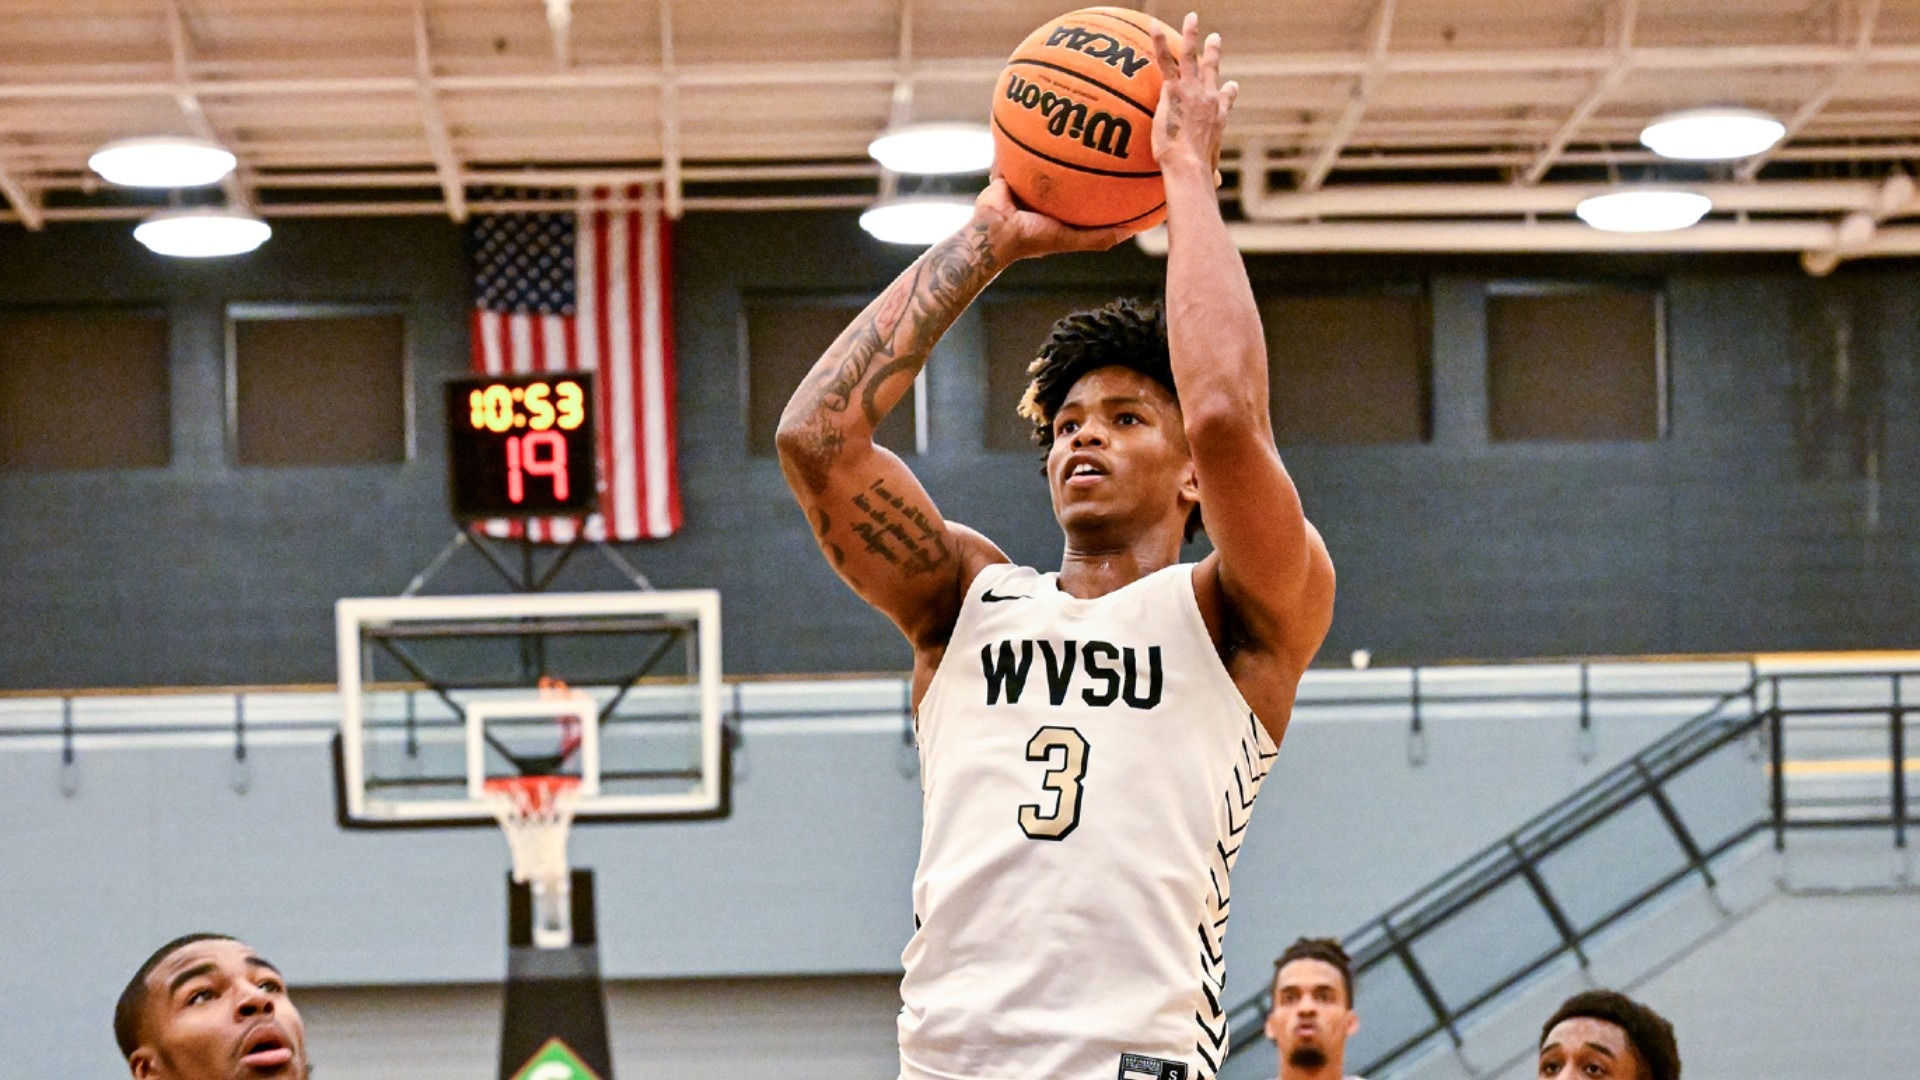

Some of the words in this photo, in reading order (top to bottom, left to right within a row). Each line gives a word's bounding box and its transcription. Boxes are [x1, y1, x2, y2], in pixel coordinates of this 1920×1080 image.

[1045, 25, 1150, 78] NCAA
[1006, 73, 1133, 160] Wilson
[469, 381, 585, 433] 10:53
[506, 429, 570, 504] 19
[981, 639, 1163, 710] WVSU
[1018, 725, 1091, 842] 3
